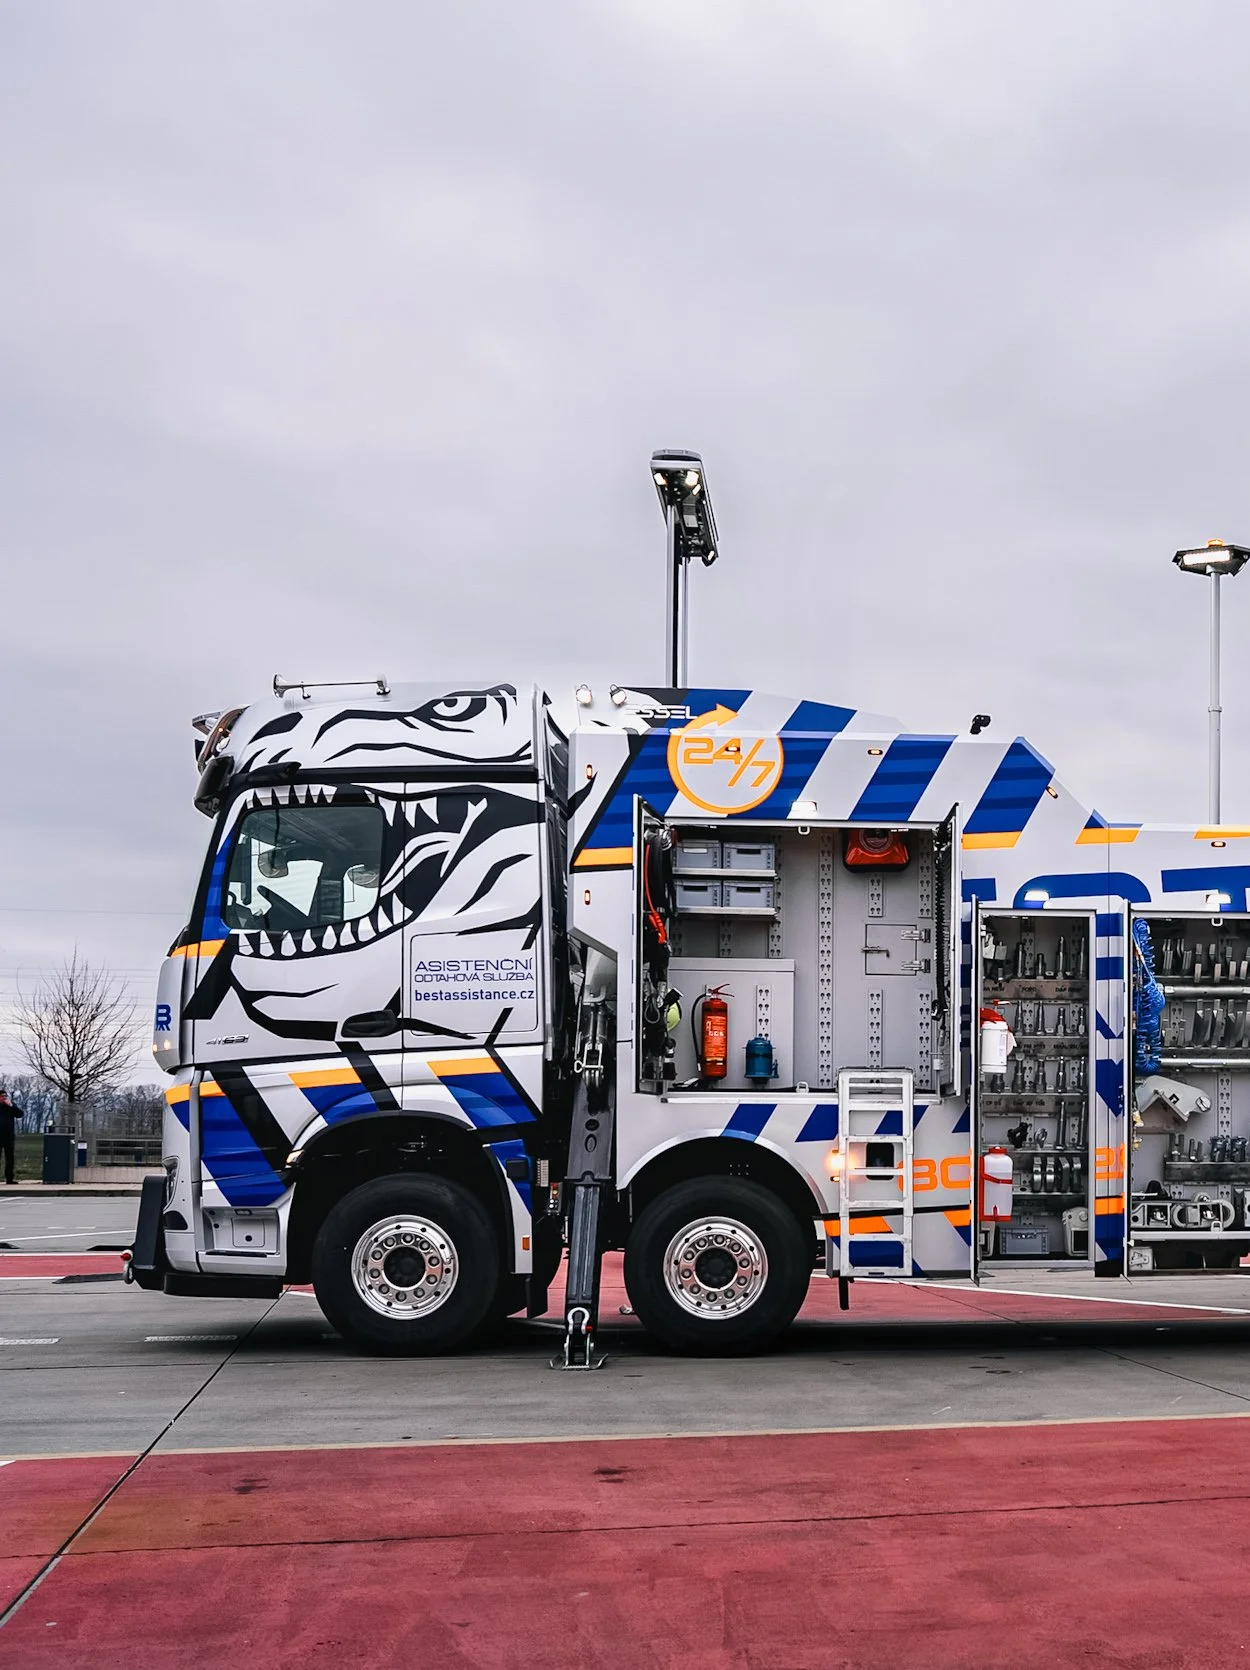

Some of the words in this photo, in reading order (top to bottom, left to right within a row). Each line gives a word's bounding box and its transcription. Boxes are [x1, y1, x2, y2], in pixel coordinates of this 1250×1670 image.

[683, 737, 776, 788] 24/7
[415, 958, 533, 972] ASISTENČNÍ
[414, 973, 480, 983] ODTAHOVÁ
[483, 972, 534, 982] SLUŽBA
[415, 989, 534, 1001] bestassistance.cz
